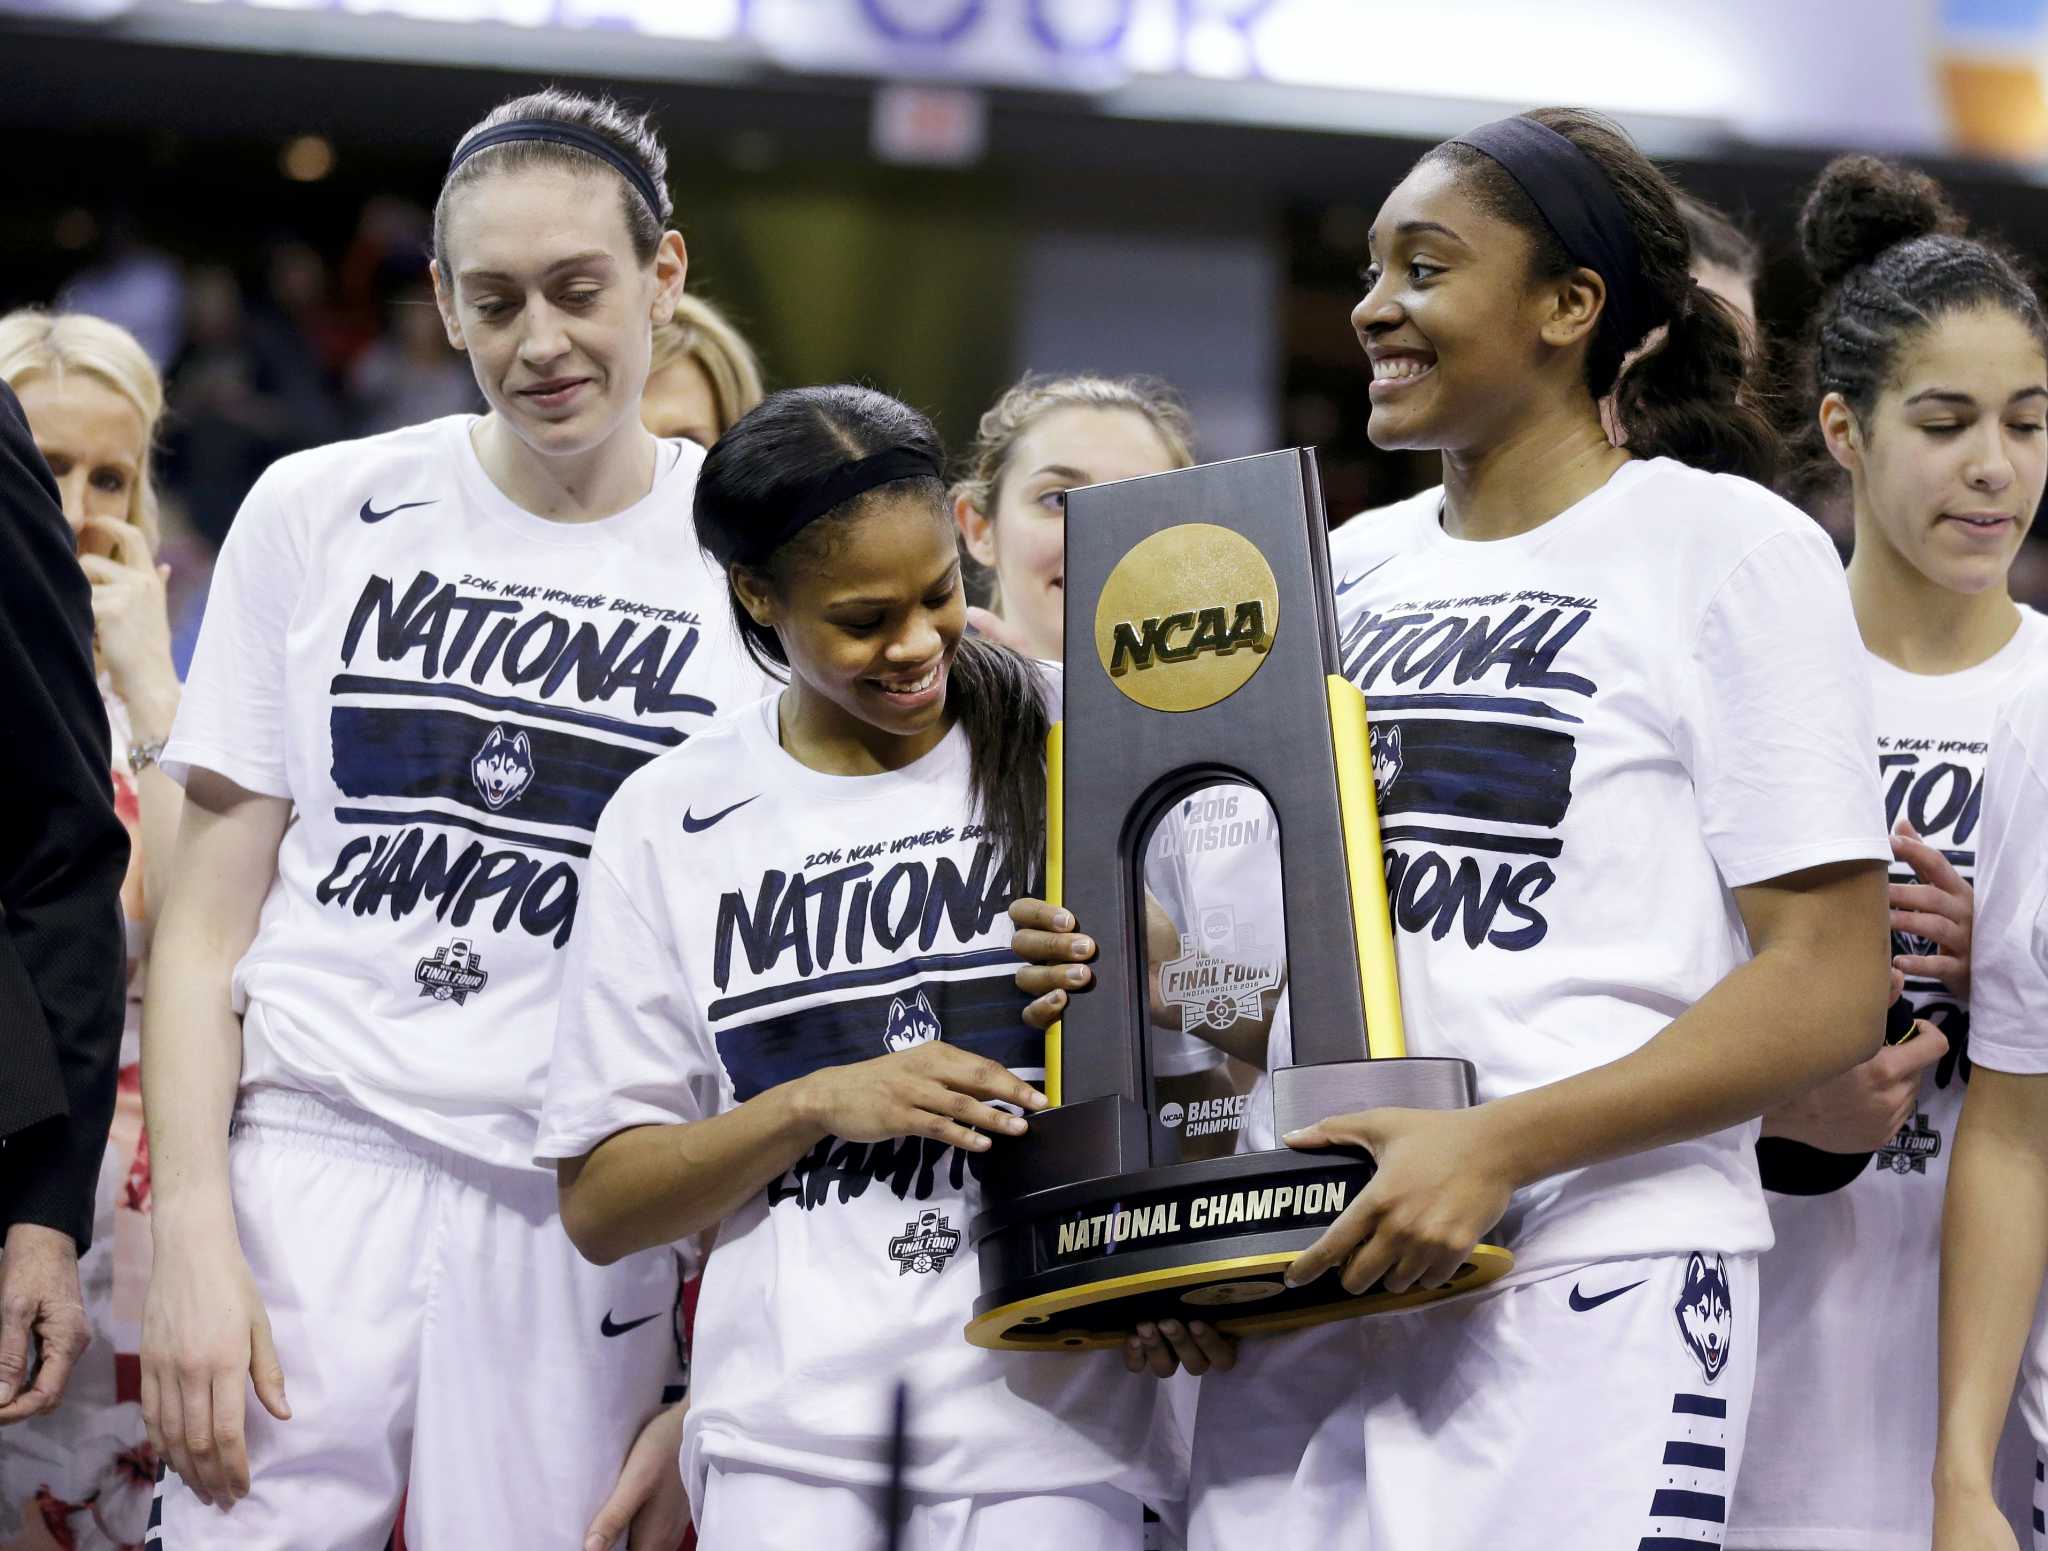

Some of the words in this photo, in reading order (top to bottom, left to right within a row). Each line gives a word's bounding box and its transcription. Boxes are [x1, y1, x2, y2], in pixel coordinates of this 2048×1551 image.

[459, 574, 498, 592] 2016
[608, 598, 702, 625] BASKETBALL
[340, 570, 717, 716] NATIONAL
[1109, 600, 1269, 678] NCAA
[1190, 796, 1240, 824] 2016
[1159, 818, 1260, 859] DIVISION
[803, 848, 842, 869] 2016
[420, 965, 452, 982] FINAL
[452, 973, 483, 987] FOUR
[1168, 966, 1219, 992] FINAL
[1904, 1136, 1936, 1150] FOUR
[1057, 1201, 1181, 1255] NATIONAL
[1189, 1181, 1347, 1229] CHAMPION
[894, 1239, 925, 1255] FINAL
[925, 1236, 956, 1250] FOUR
